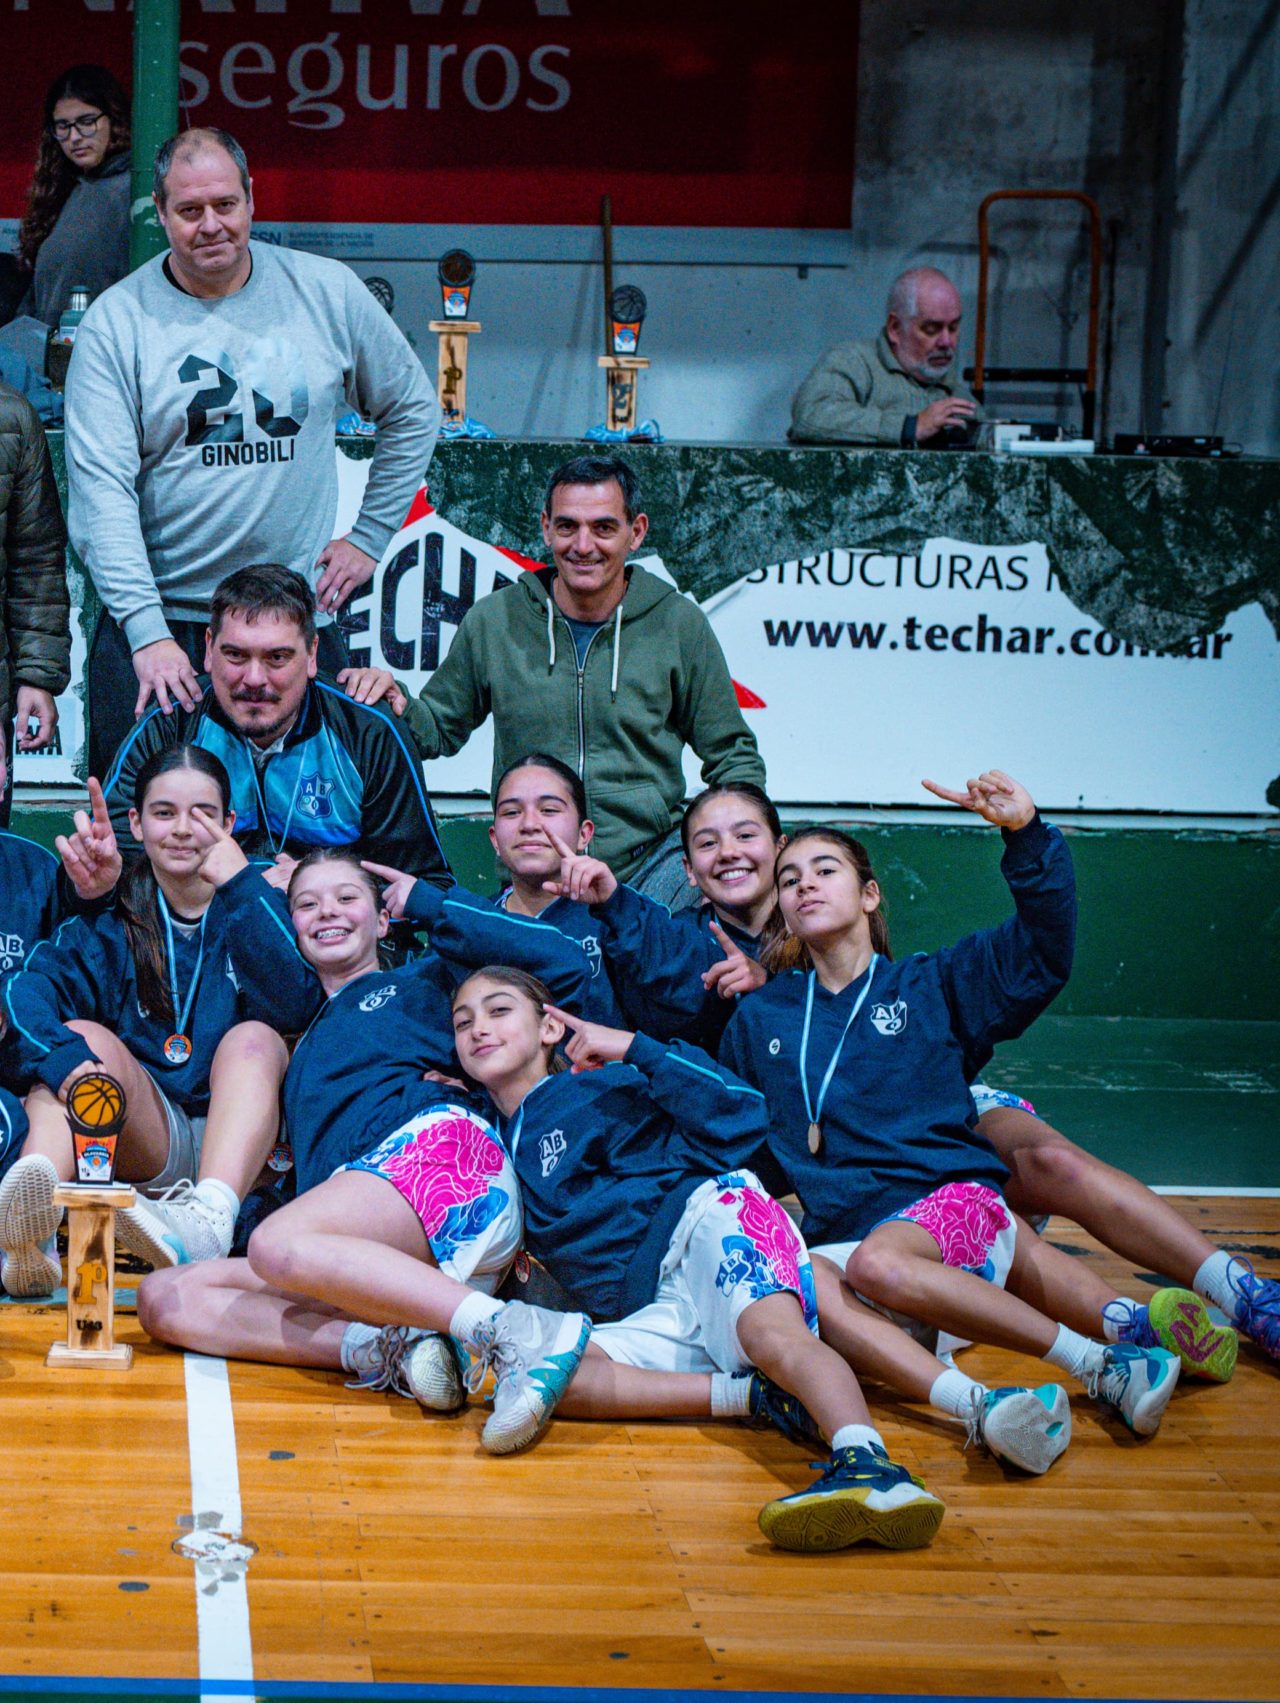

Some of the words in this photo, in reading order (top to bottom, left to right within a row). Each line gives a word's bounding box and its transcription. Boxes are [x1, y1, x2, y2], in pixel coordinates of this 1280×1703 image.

[178, 32, 572, 130] seguros
[201, 438, 295, 467] GINOBILI
[746, 550, 1030, 592] RUCTURAS
[336, 531, 518, 672] ECH
[763, 613, 1233, 660] www.techar.coar
